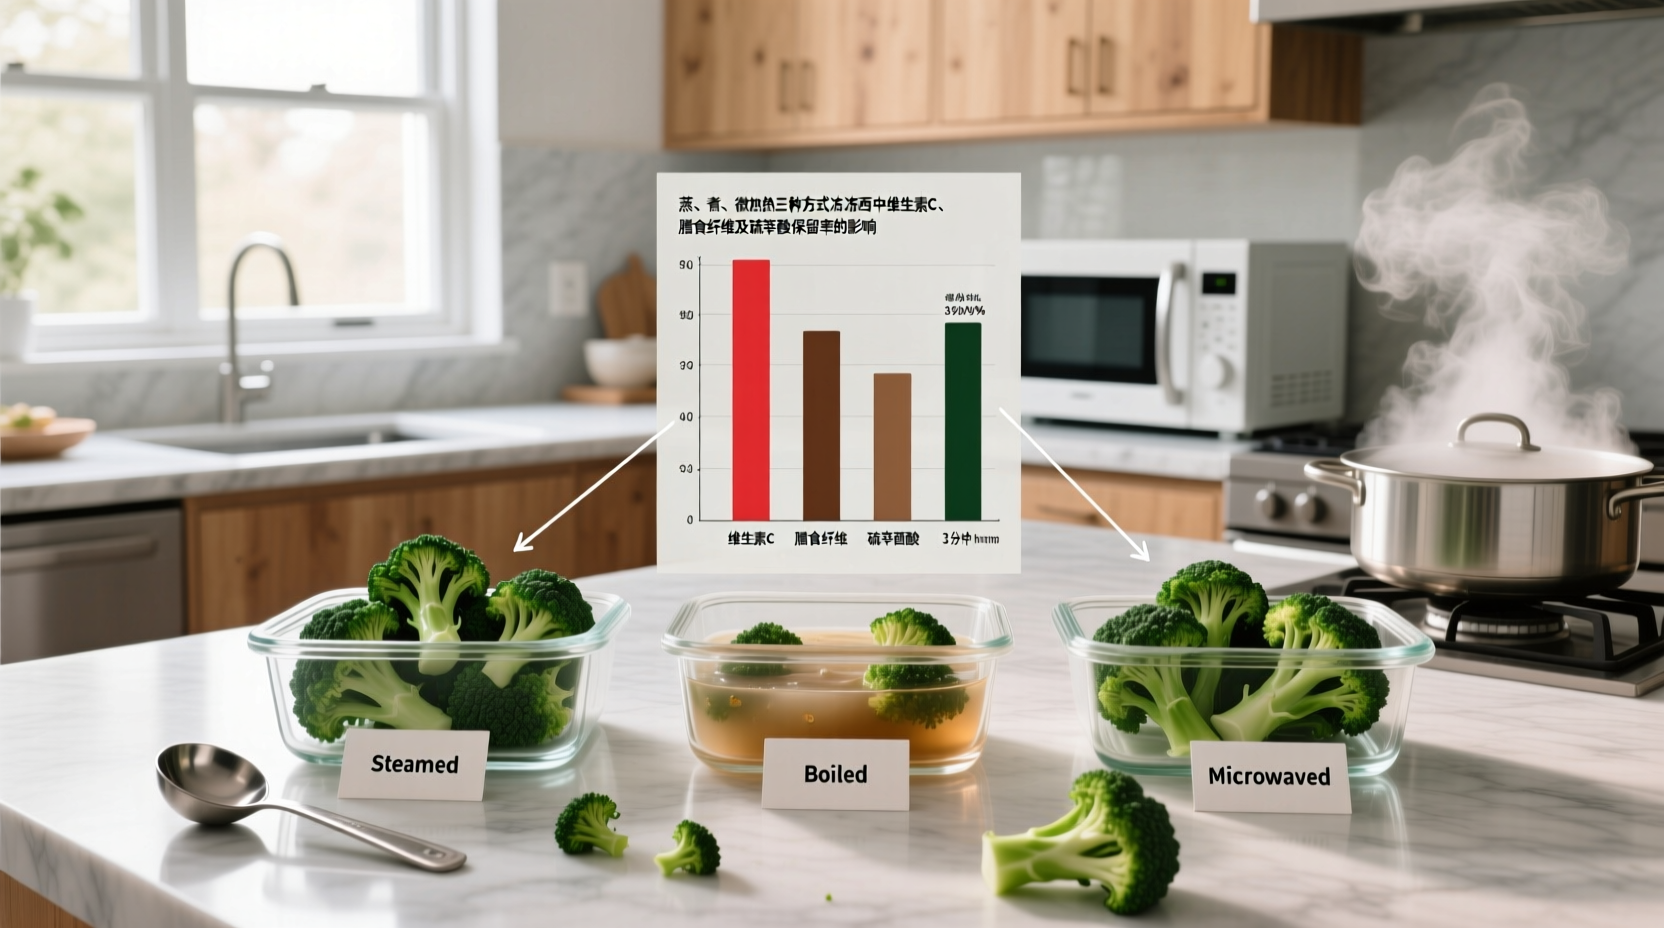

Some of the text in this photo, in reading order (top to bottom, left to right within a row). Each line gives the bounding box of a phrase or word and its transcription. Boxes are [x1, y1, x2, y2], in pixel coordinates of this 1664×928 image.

[686, 514, 694, 525] 0
[370, 754, 459, 774] Steamed
[804, 763, 868, 784] Boiled
[1208, 765, 1331, 787] Microwaved
